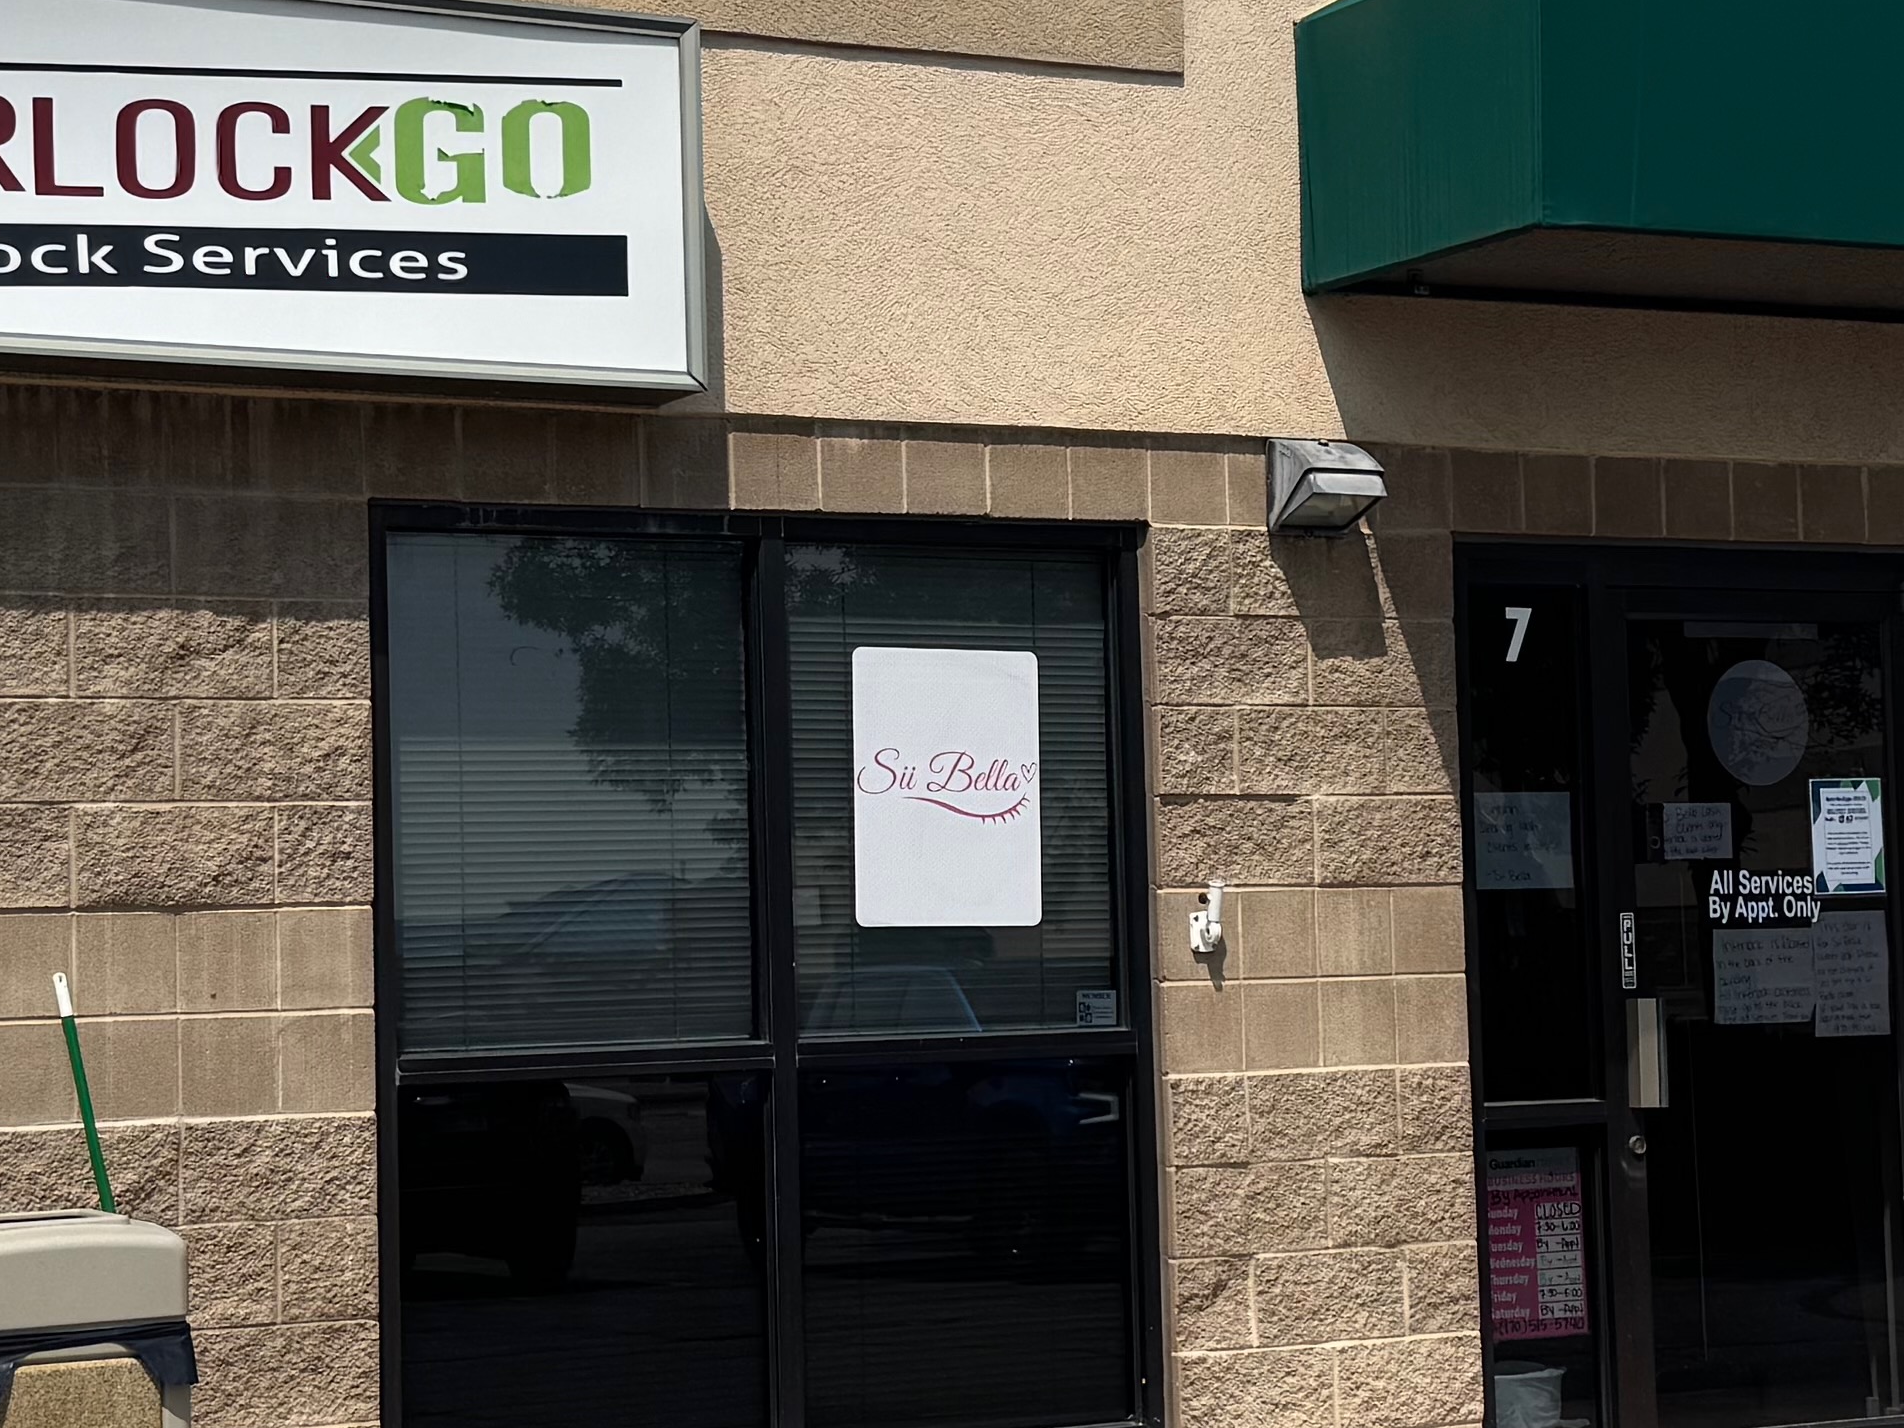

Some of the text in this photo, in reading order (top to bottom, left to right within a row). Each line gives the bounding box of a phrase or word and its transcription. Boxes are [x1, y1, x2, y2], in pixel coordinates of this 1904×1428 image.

[141, 233, 470, 282] Services
[1505, 606, 1533, 662] 7
[857, 747, 1022, 794] Sii Bella
[1709, 869, 1813, 895] All Services
[1708, 895, 1821, 924] By Appt. Only
[1623, 918, 1634, 971] PULL
[1489, 1158, 1536, 1171] Guardian
[1535, 1202, 1582, 1220] CLOSED
